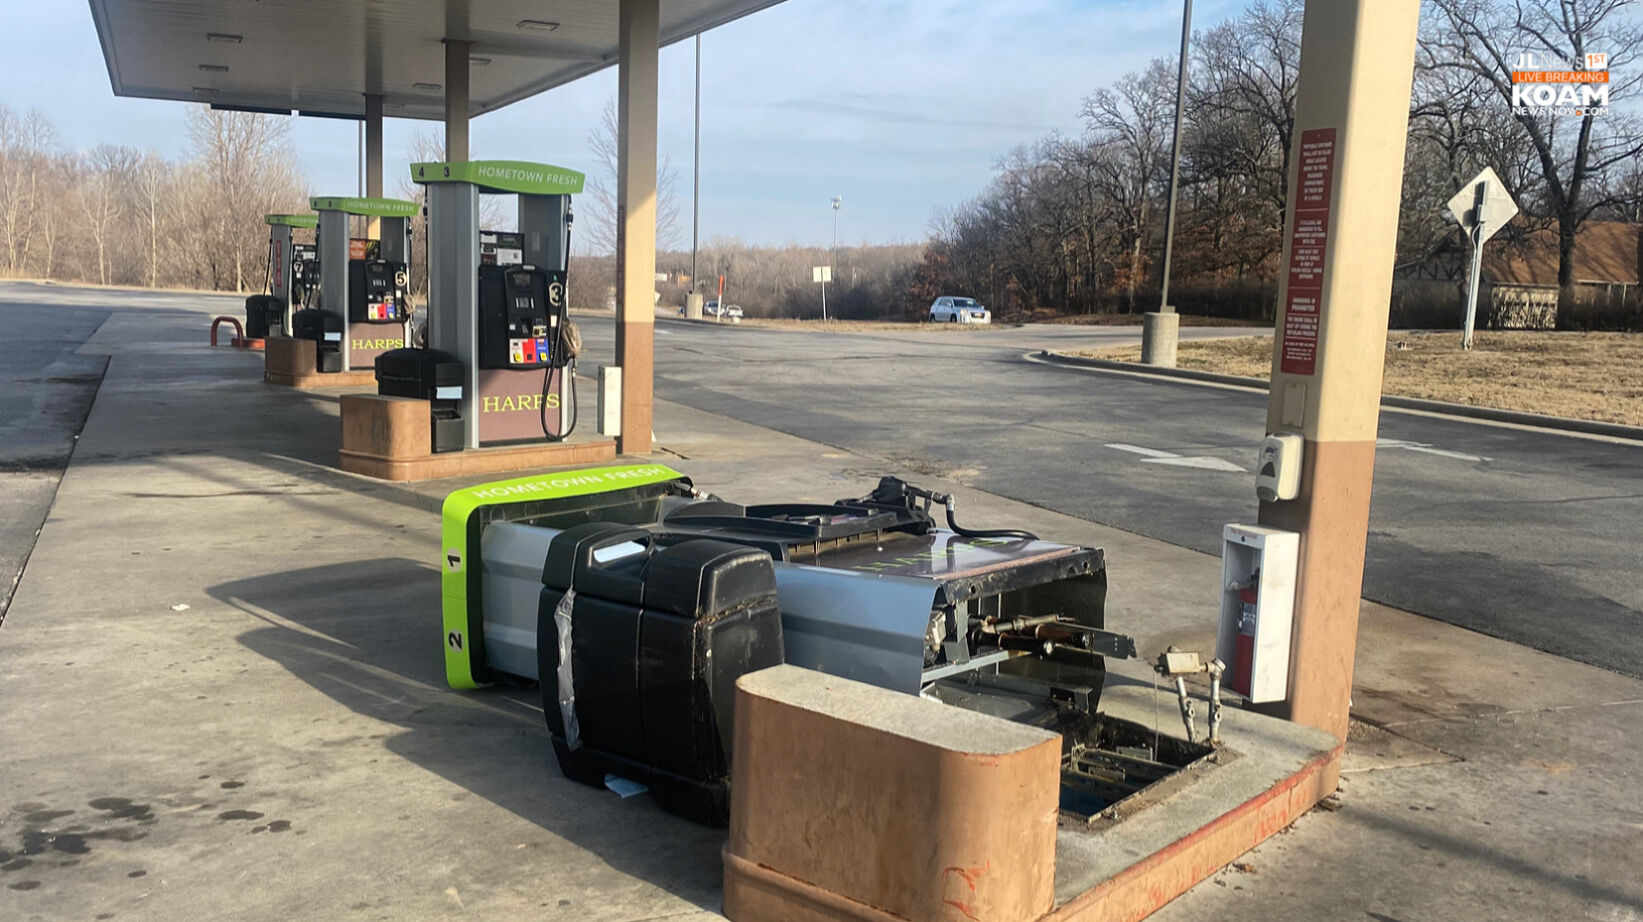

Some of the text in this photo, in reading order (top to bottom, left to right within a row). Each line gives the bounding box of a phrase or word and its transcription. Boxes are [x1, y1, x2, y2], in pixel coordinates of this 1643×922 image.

[418, 166, 425, 178] 4
[444, 166, 450, 178] 3
[478, 166, 578, 186] HOMETOWN FRESH
[397, 272, 405, 286] 5
[550, 284, 562, 304] 3
[352, 338, 404, 350] HARPS
[472, 467, 665, 499] HOMETOWN FRESH
[447, 554, 461, 568] 1
[448, 632, 462, 650] 2
